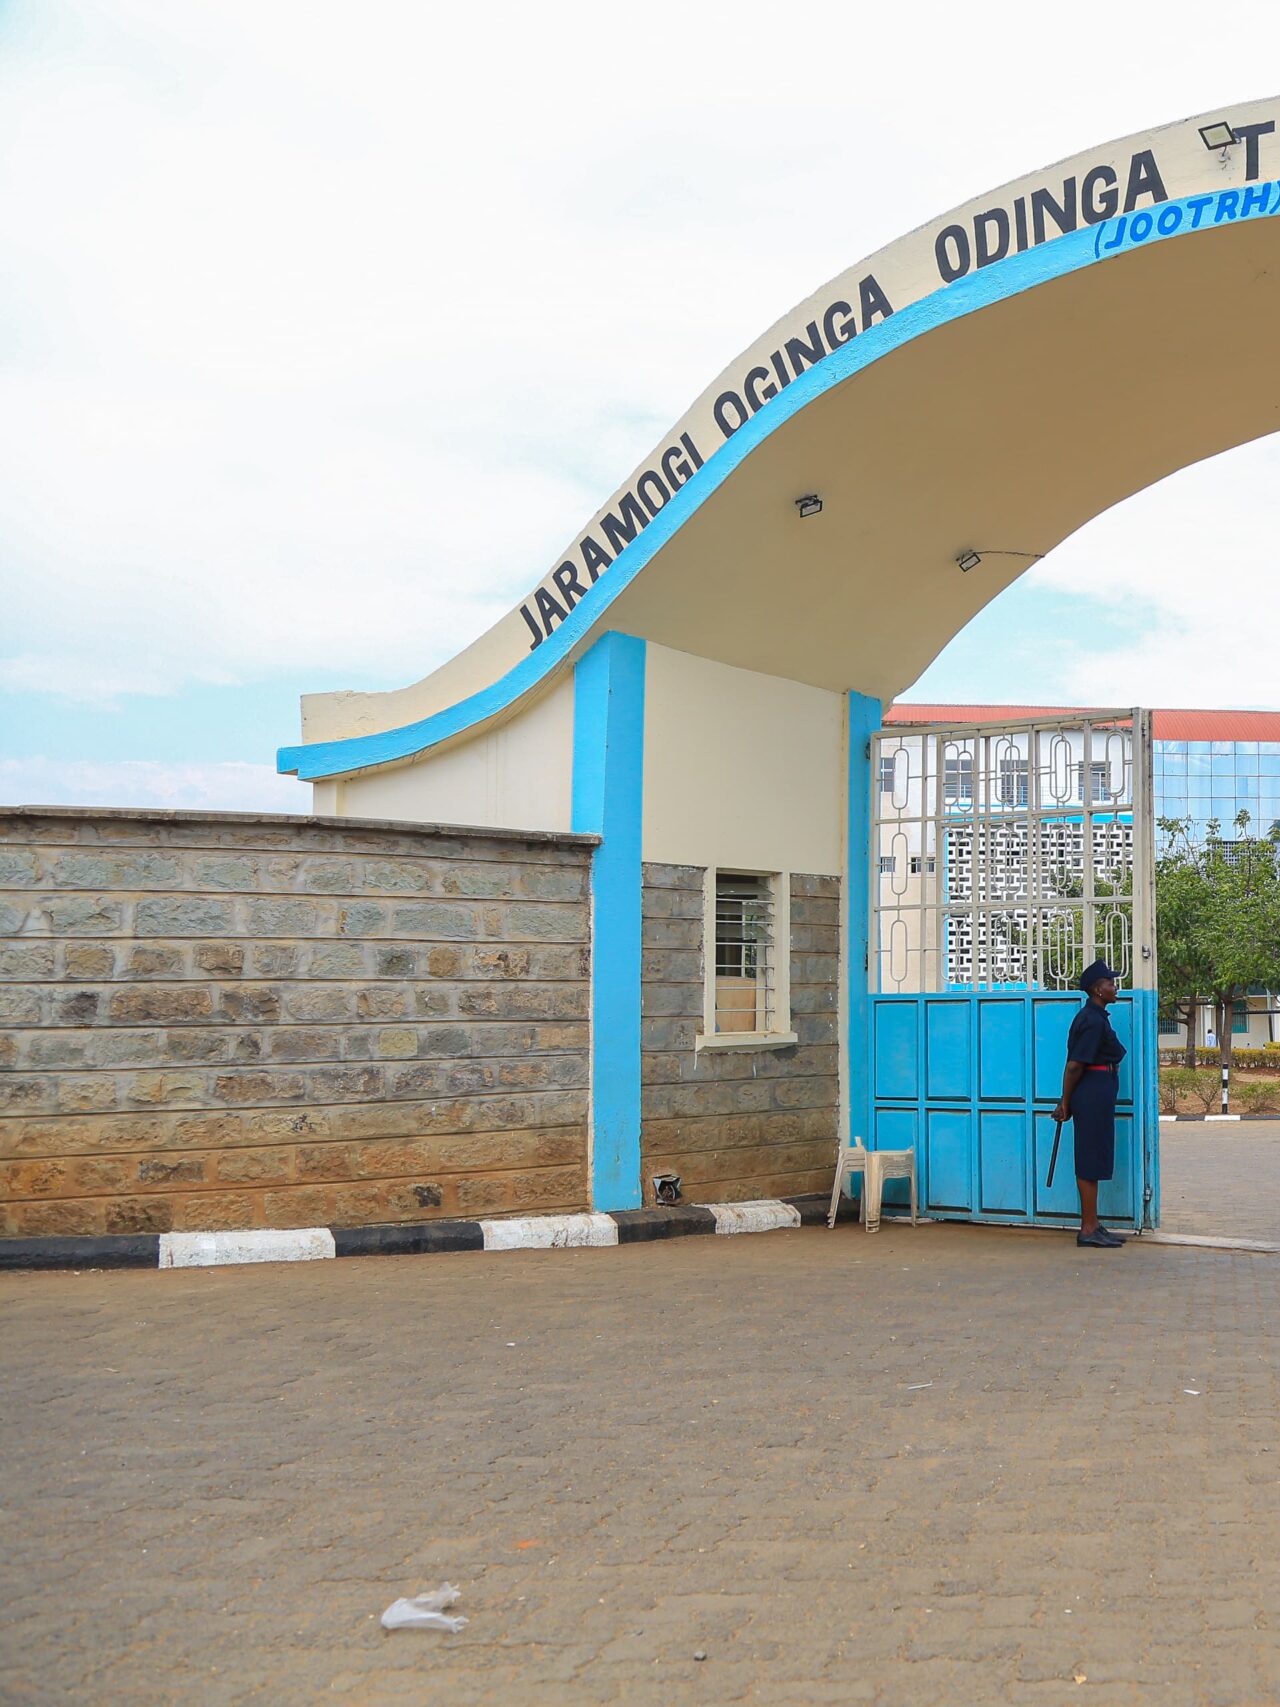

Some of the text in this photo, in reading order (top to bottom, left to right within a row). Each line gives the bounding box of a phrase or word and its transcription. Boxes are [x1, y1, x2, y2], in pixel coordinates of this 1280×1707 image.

[519, 431, 705, 652] JARAMOGI
[713, 273, 895, 440] OGINGA
[934, 149, 1169, 285] ODINGA
